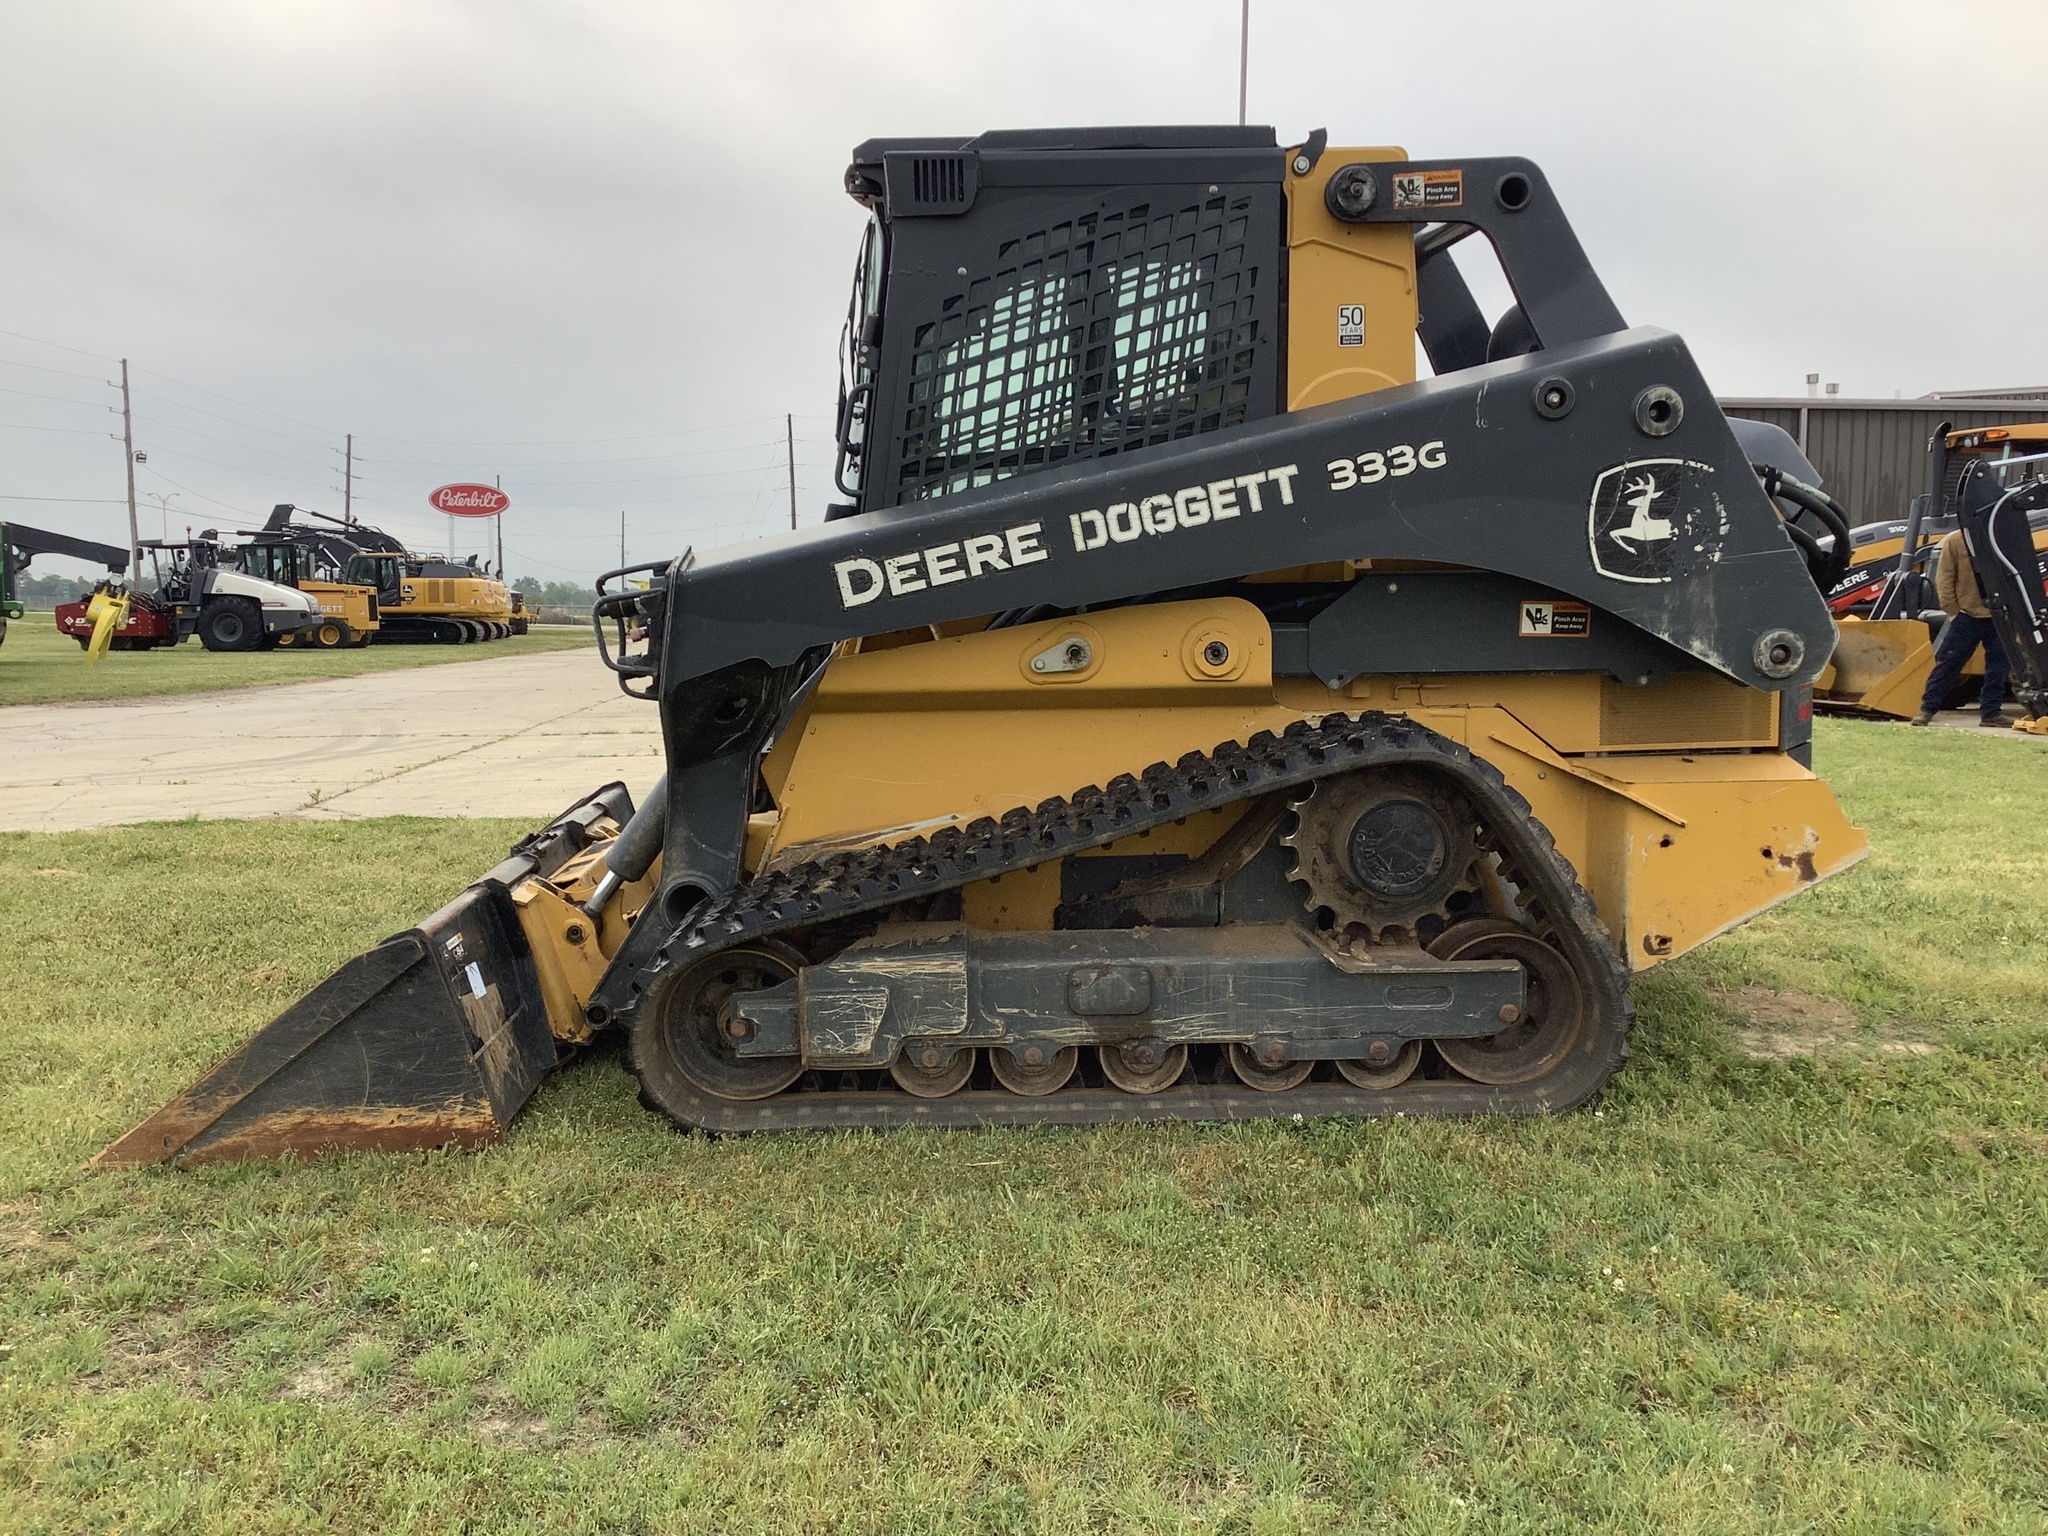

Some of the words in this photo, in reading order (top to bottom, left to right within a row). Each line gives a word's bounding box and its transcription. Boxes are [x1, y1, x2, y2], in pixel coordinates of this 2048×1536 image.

[1426, 186, 1444, 194] Pinch
[1440, 193, 1454, 201] Away
[1340, 307, 1363, 326] 50
[439, 489, 503, 508] Peterbilt
[834, 522, 1049, 608] DEERE
[1068, 464, 1299, 553] DOGGETT
[1327, 440, 1448, 491] 333G
[1887, 525, 1908, 533] 310
[320, 605, 343, 613] GETT
